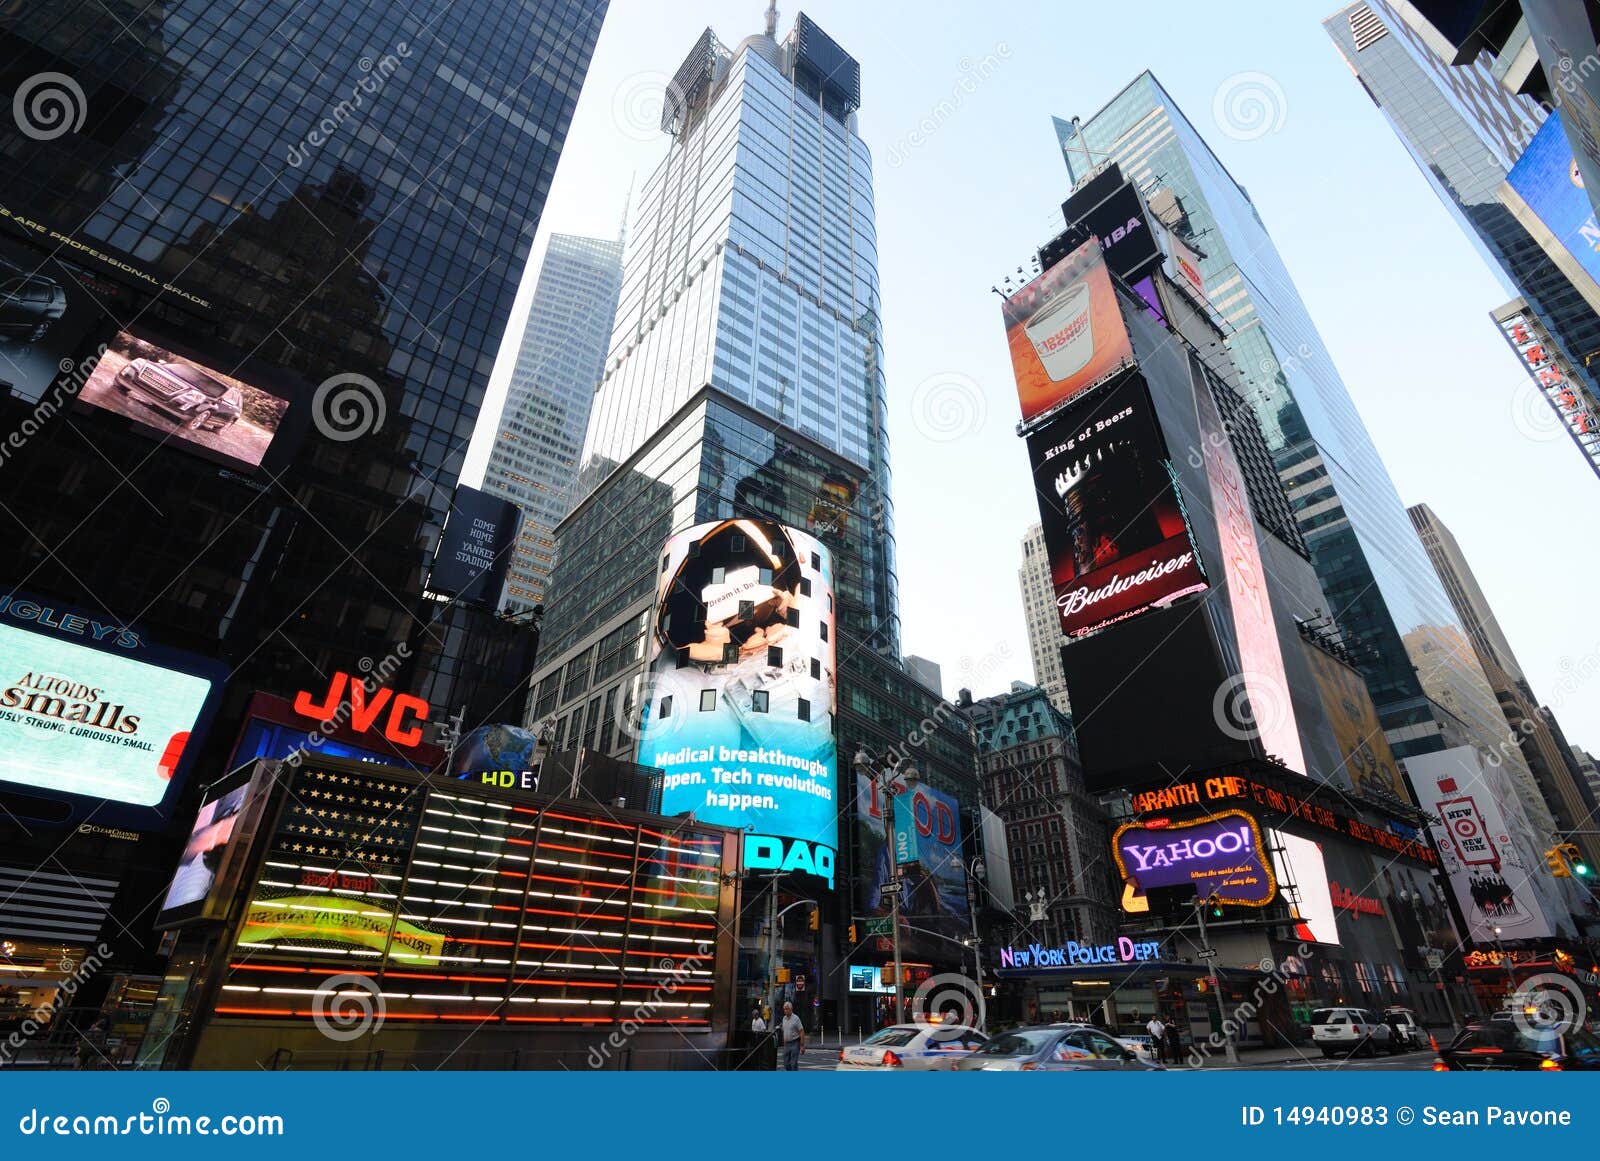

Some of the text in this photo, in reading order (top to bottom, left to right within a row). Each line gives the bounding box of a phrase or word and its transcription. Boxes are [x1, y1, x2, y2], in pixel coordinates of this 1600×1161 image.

[1101, 217, 1141, 251] IBA
[16, 215, 47, 233] ARE
[50, 231, 159, 286] PROFESSIONAL
[1044, 406, 1134, 461] King of Beers
[470, 528, 495, 544] HOME
[472, 518, 497, 533] COME
[455, 551, 494, 571] STADIUM
[462, 541, 496, 560] YANKEE
[708, 592, 734, 608] Dream
[744, 582, 755, 592] Do
[1056, 551, 1193, 617] Budweiser
[1069, 605, 1149, 637] Budweiser
[0, 686, 141, 735] smalls
[294, 671, 429, 747] JVC
[24, 716, 67, 734] STRONG.
[69, 726, 123, 745] CURIOUSLY
[655, 745, 828, 778] Medical breakthroughs
[481, 771, 515, 788] HD
[711, 767, 752, 785] Tech
[757, 770, 832, 801] revolutions
[706, 789, 779, 811] happen.
[1447, 807, 1473, 820] NEW
[897, 831, 909, 860] UNO
[1123, 825, 1251, 872] YAHOO!
[1461, 836, 1482, 847] NEW
[1464, 843, 1487, 854] YORK
[744, 835, 835, 891] DAQ
[1001, 937, 1160, 968] NEW YORK POLICE DEPT
